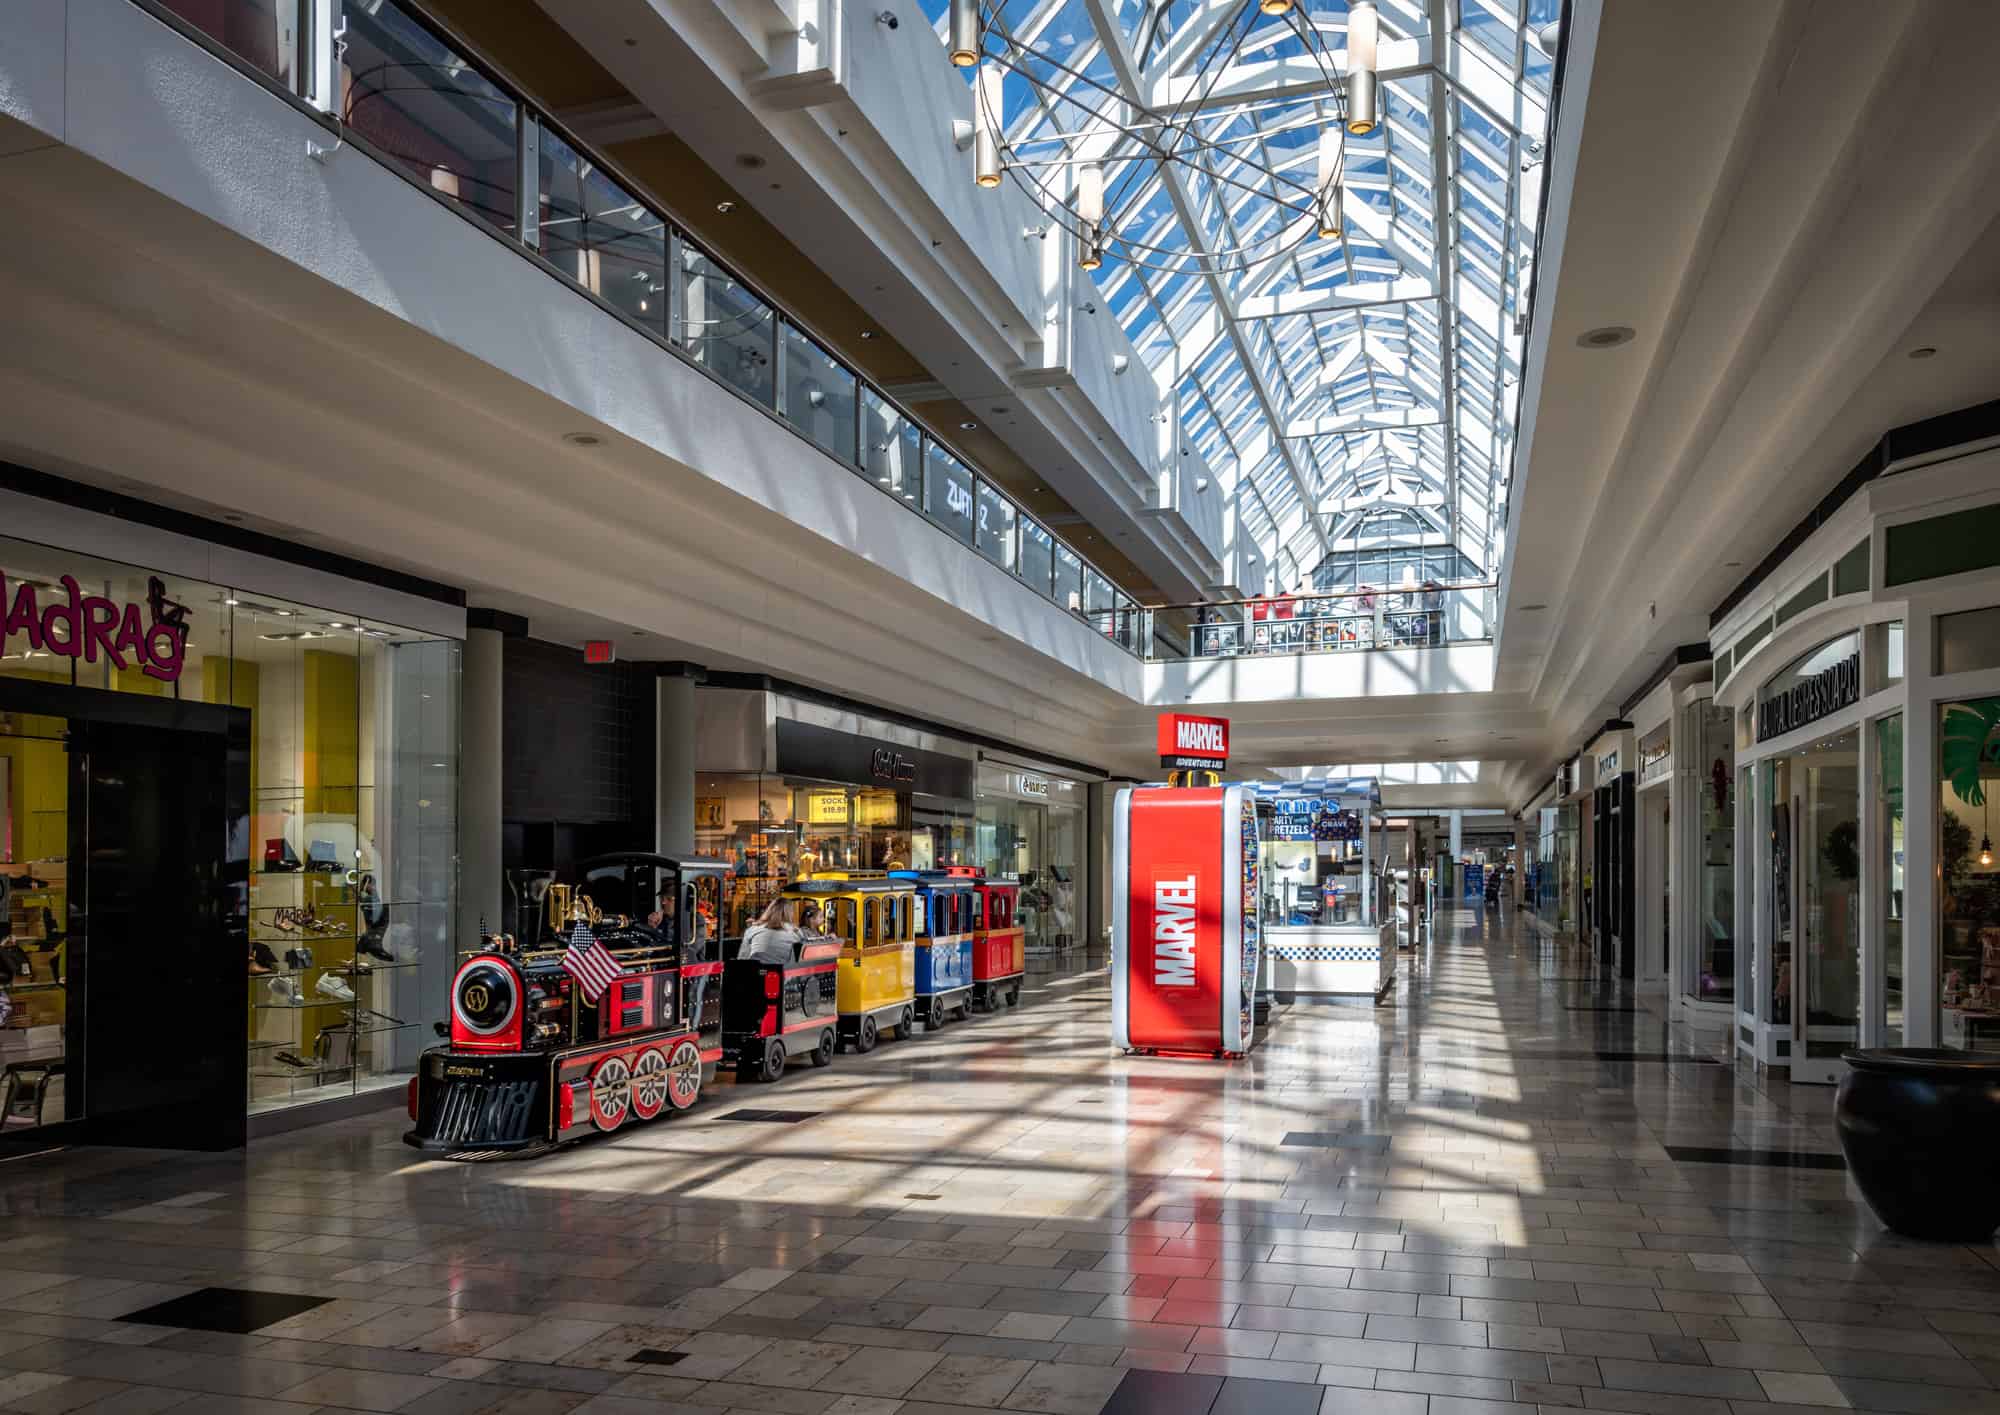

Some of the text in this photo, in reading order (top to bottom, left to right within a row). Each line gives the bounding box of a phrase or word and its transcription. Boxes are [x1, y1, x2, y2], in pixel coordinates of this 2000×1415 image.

[1177, 720, 1224, 751] MARVEL
[1275, 797, 1340, 814] nne's
[1155, 875, 1196, 985] MARVEL
